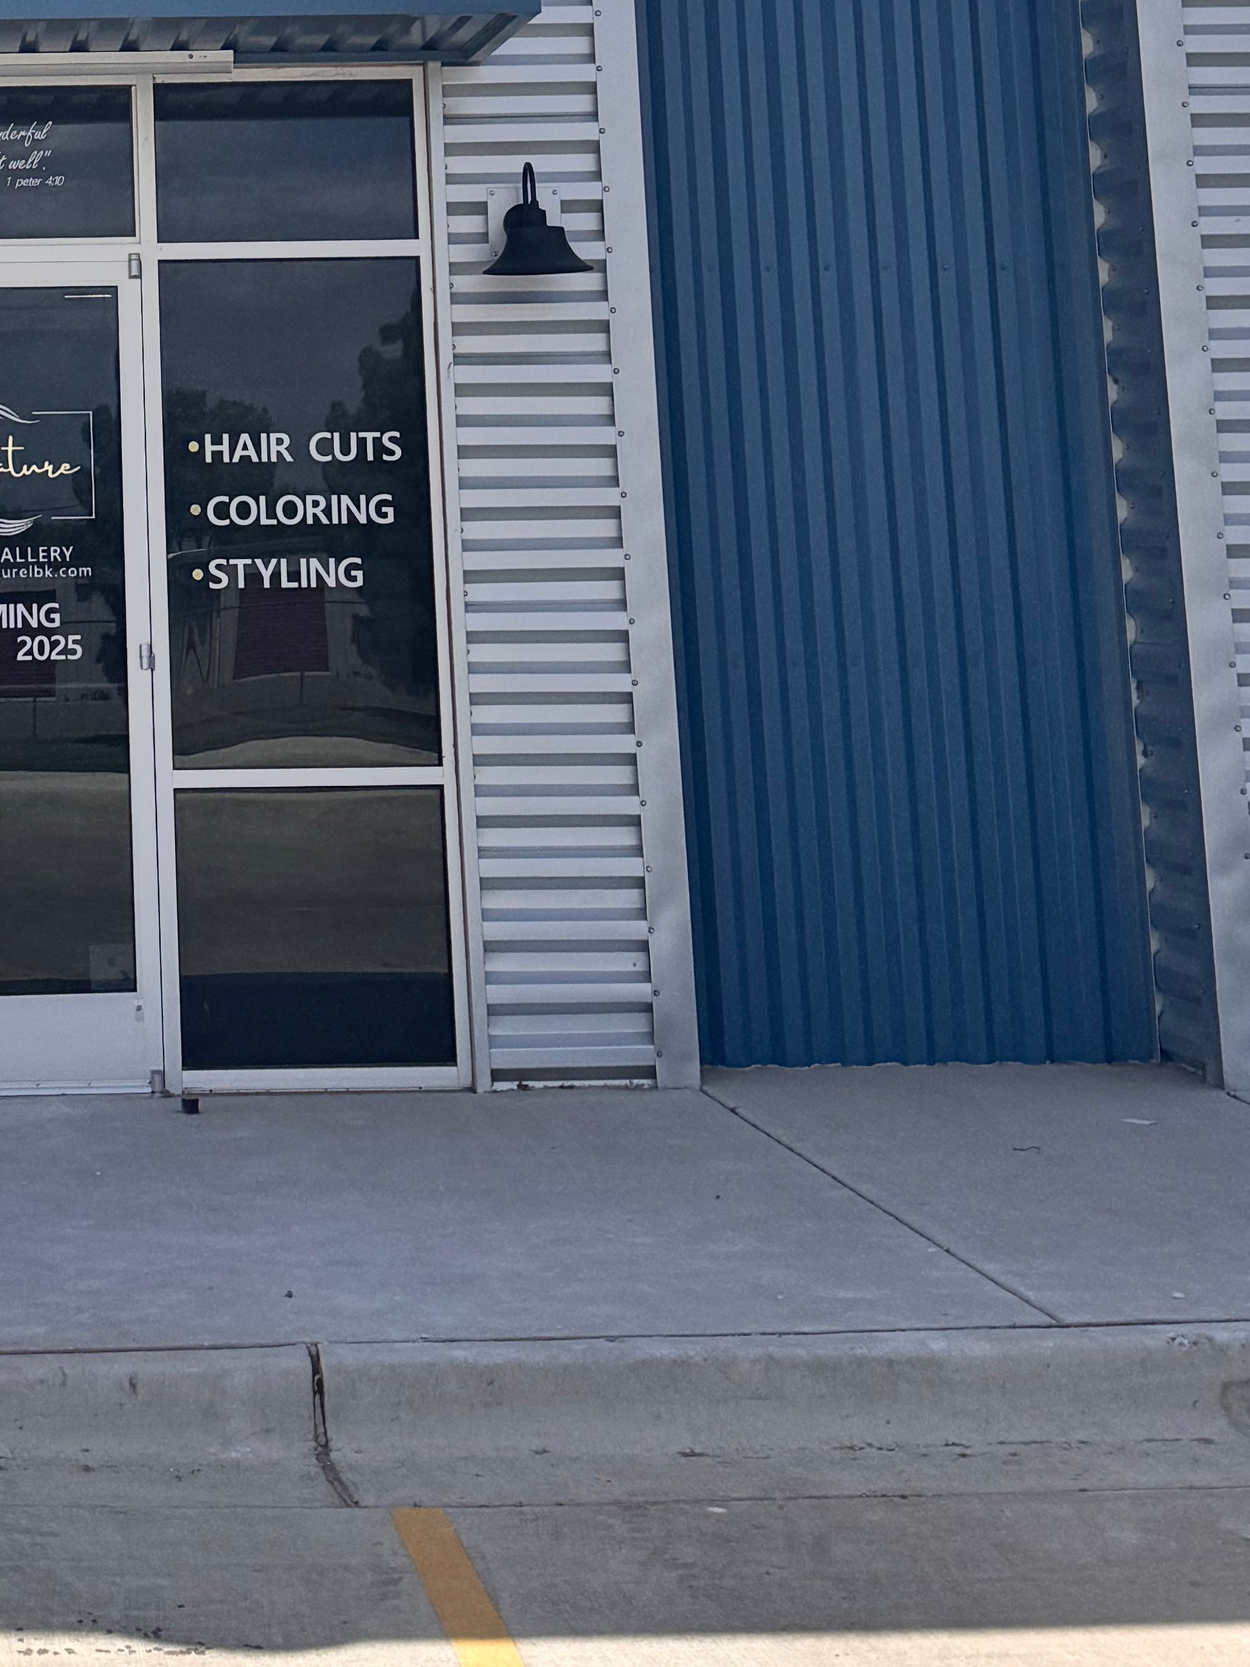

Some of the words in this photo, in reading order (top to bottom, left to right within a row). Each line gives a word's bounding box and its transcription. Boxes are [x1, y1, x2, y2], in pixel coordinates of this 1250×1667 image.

[204, 432, 294, 463] HAIR
[308, 431, 403, 463] CUTS
[206, 493, 395, 526] COLORING
[207, 557, 364, 590] STYLING
[16, 634, 83, 661] 2025
